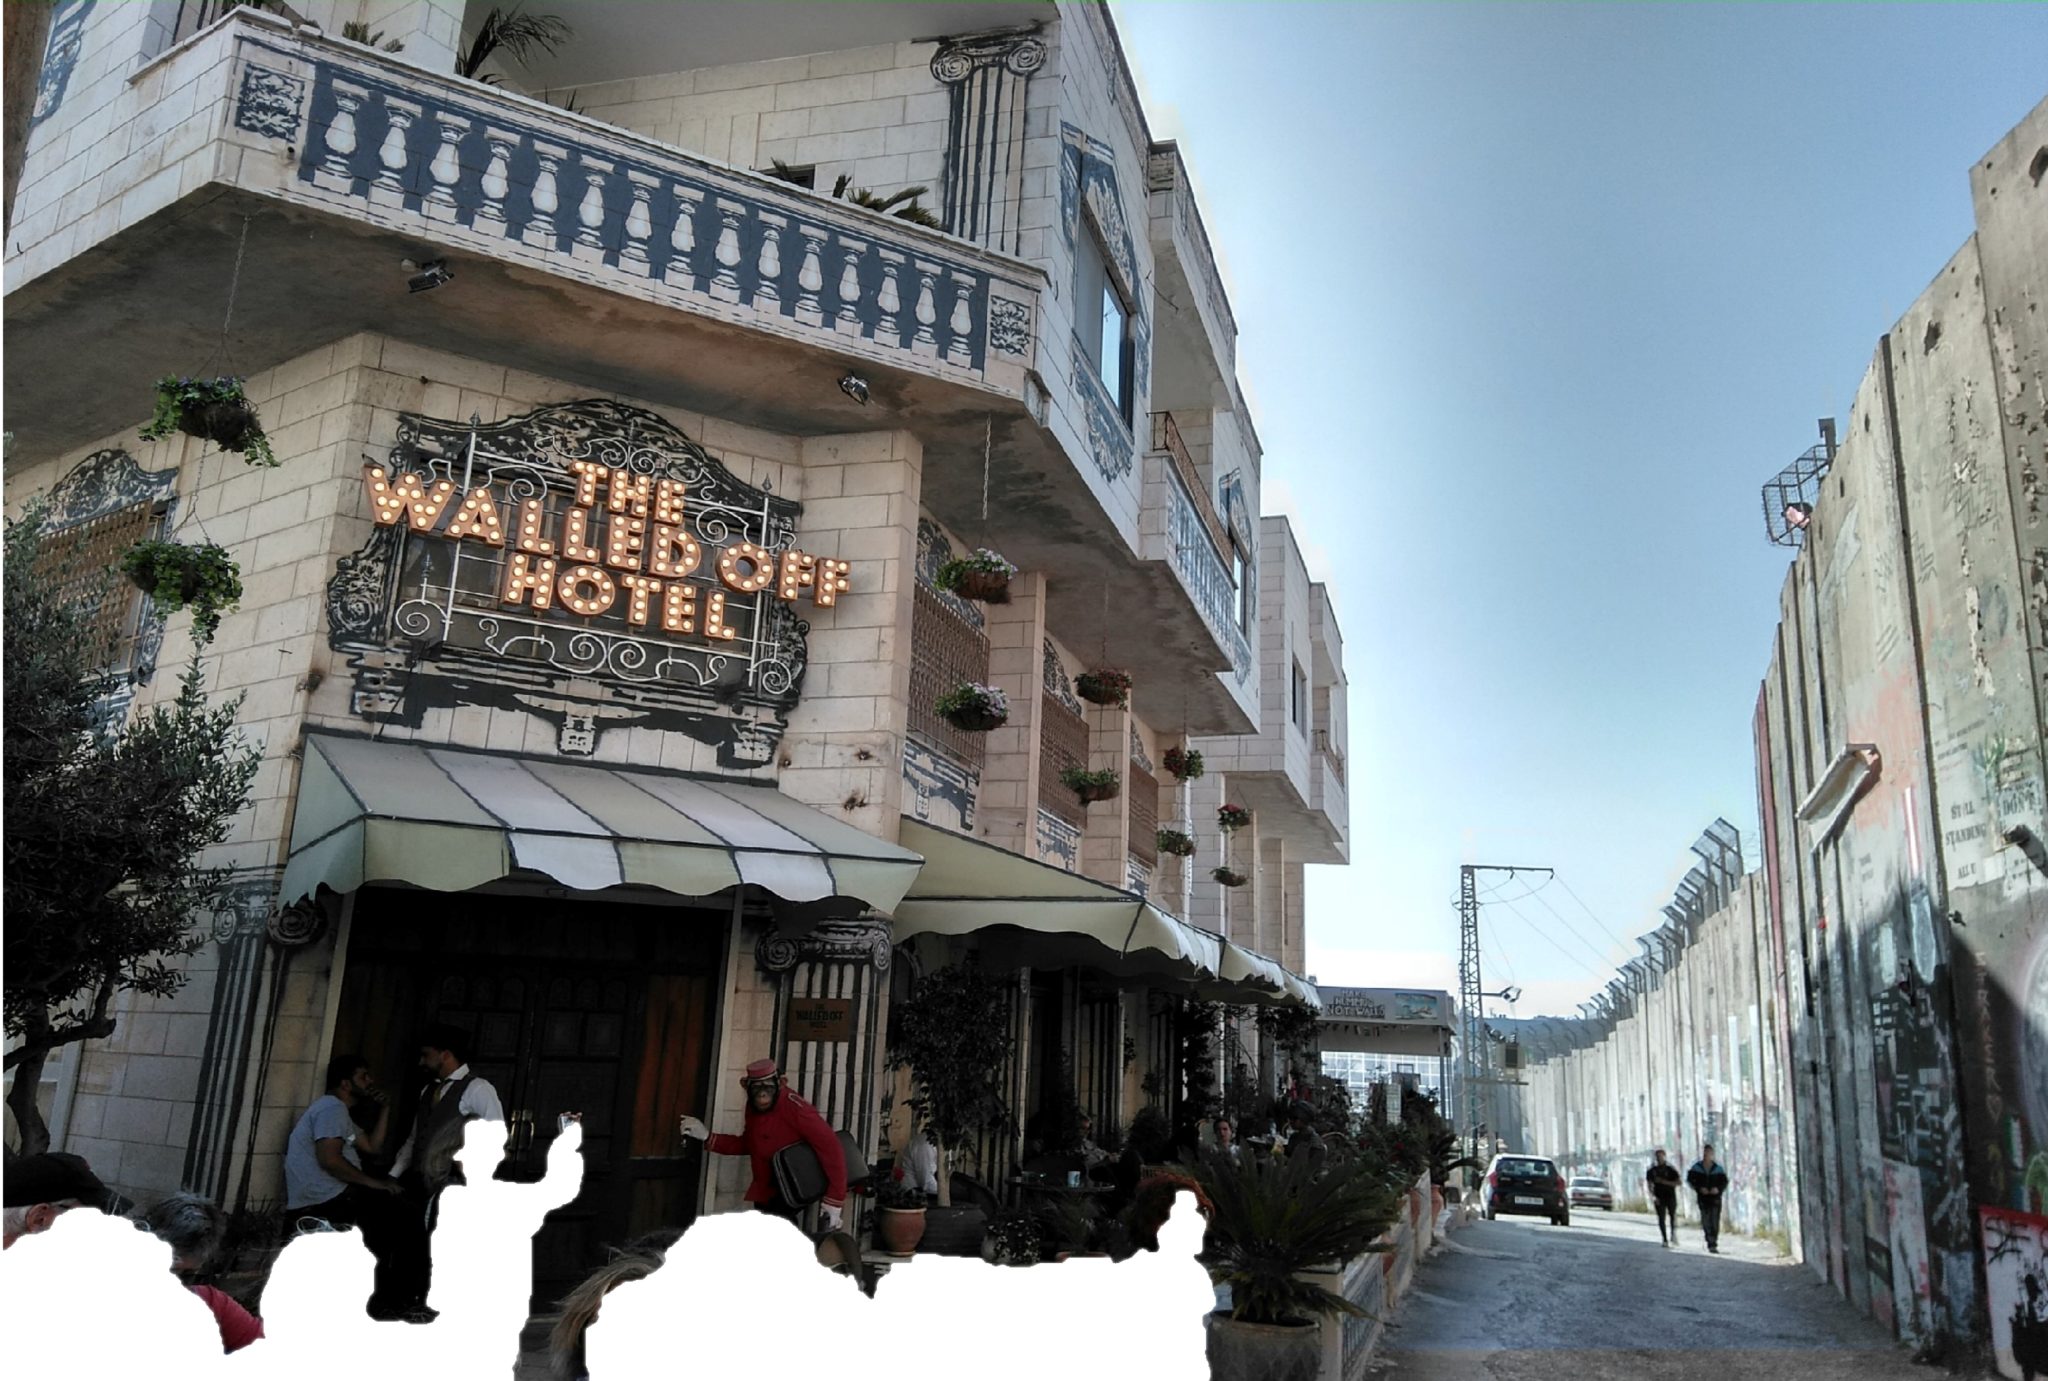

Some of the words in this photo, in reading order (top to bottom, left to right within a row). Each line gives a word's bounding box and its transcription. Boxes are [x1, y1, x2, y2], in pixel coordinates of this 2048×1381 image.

[568, 460, 686, 527] THE
[362, 463, 702, 578] WALLED
[715, 541, 852, 608] OFF
[501, 552, 736, 641] HOTEL
[1326, 1004, 1351, 1017] NOT
